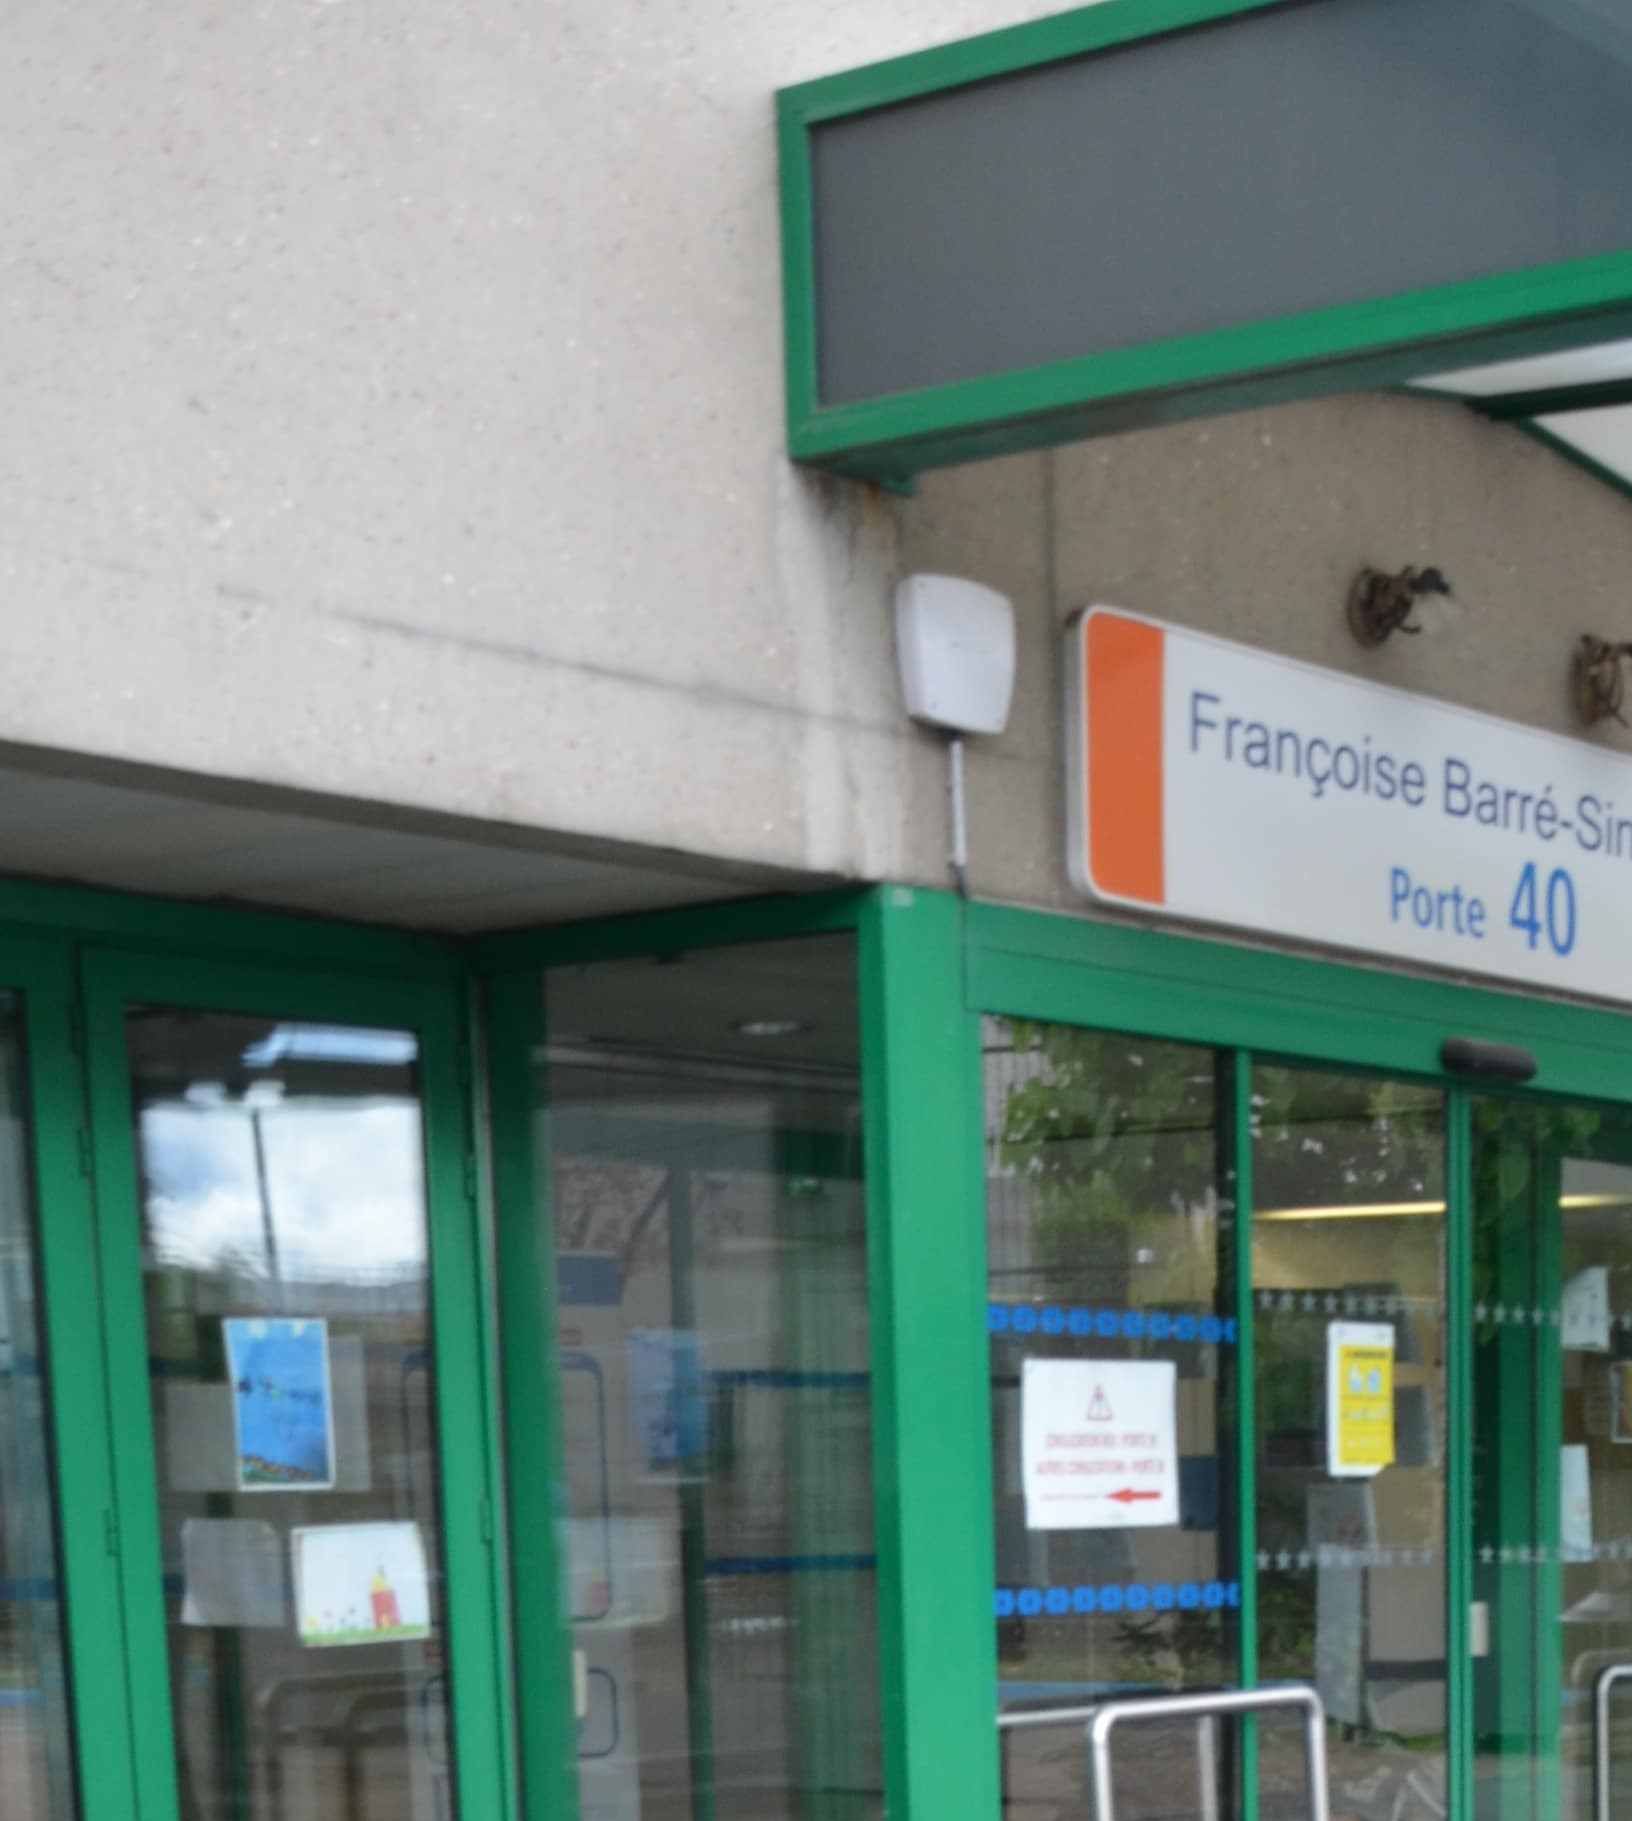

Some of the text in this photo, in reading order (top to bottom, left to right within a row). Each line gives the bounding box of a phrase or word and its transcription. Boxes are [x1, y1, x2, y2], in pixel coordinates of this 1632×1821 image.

[1190, 690, 1426, 807] Françoise
[1390, 860, 1578, 958] Porte 40
